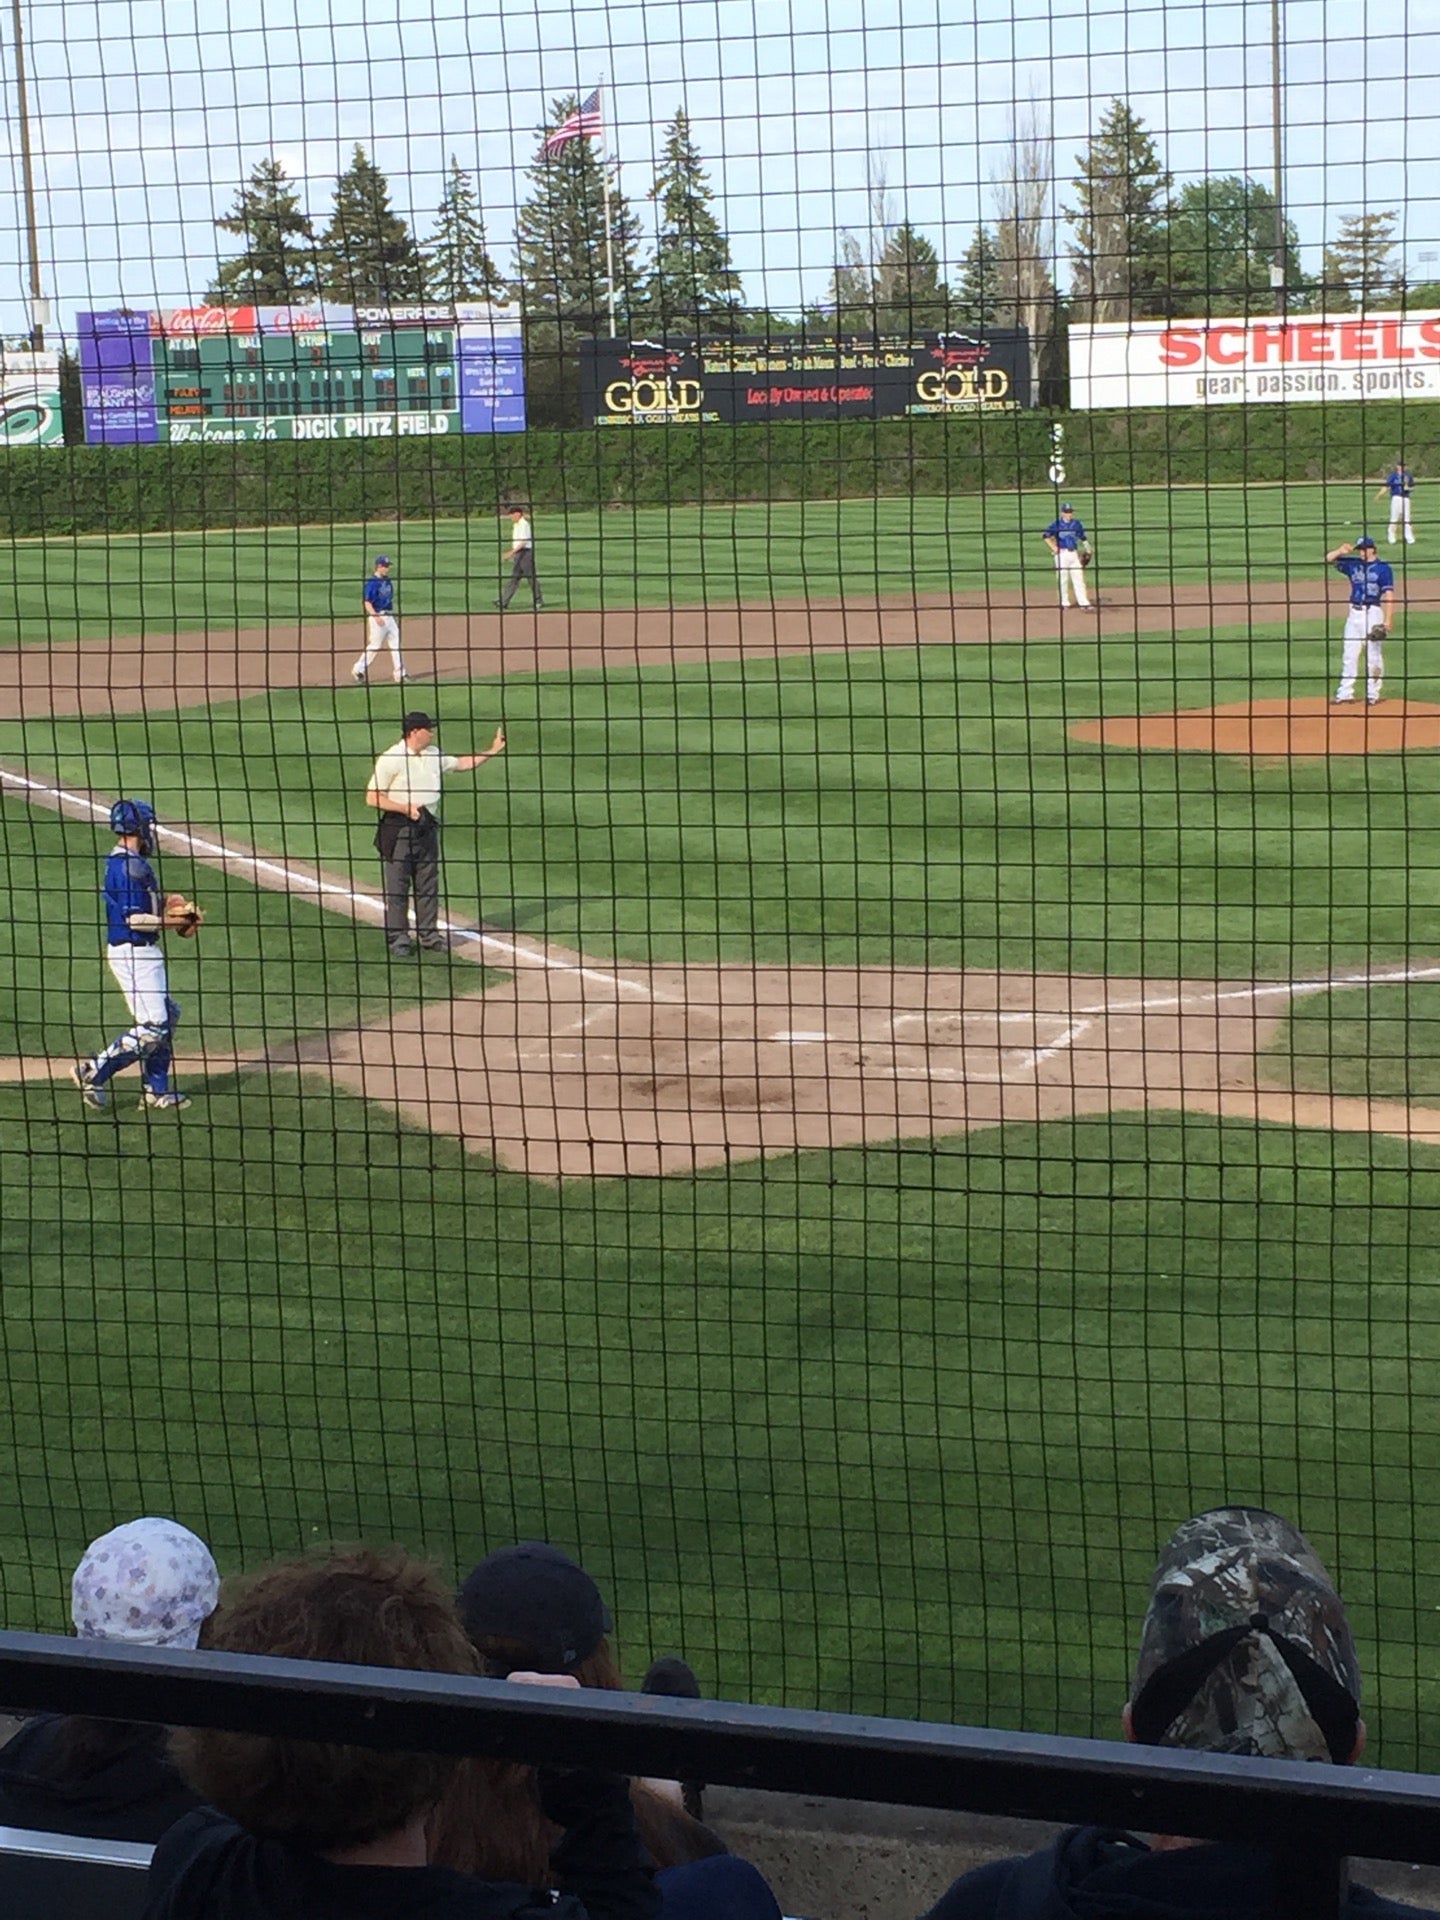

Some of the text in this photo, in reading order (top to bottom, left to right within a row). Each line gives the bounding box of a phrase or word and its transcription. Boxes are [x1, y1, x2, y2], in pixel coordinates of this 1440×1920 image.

[1158, 318, 1440, 366] SCHEELS
[604, 379, 704, 411] GOLD
[916, 369, 1009, 402] GOLD
[1196, 367, 1433, 399] gear. passion. sports.
[170, 415, 449, 443] Welcome To DICK PUTZ FIELD
